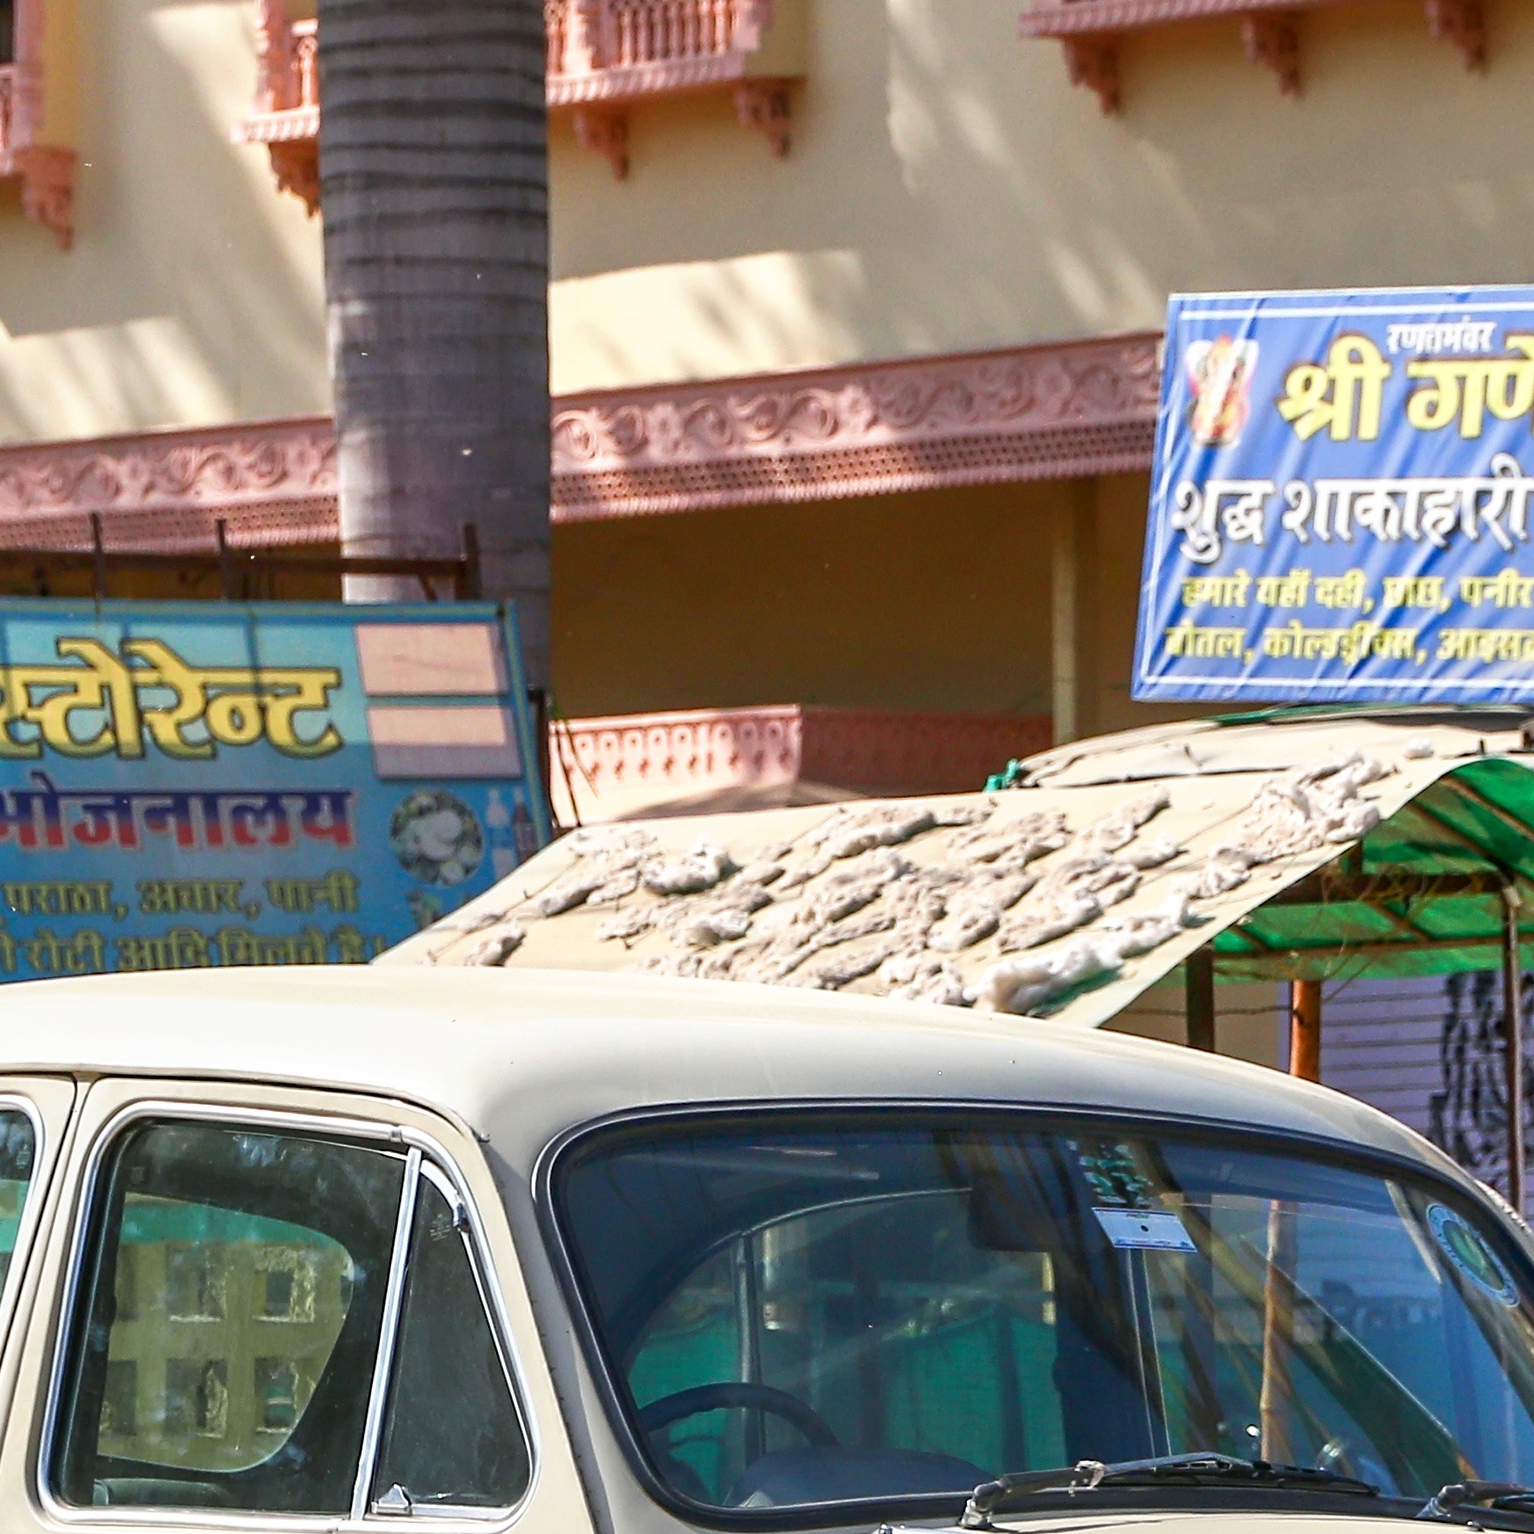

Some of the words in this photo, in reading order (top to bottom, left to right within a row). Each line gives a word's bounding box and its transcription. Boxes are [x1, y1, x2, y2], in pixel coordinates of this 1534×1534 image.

[1277, 331, 1392, 442] श्री
[1170, 477, 1275, 564] शुद्ध
[1182, 567, 1251, 608] हमारे
[264, 868, 360, 913] पानी
[22, 928, 105, 971] रोटी
